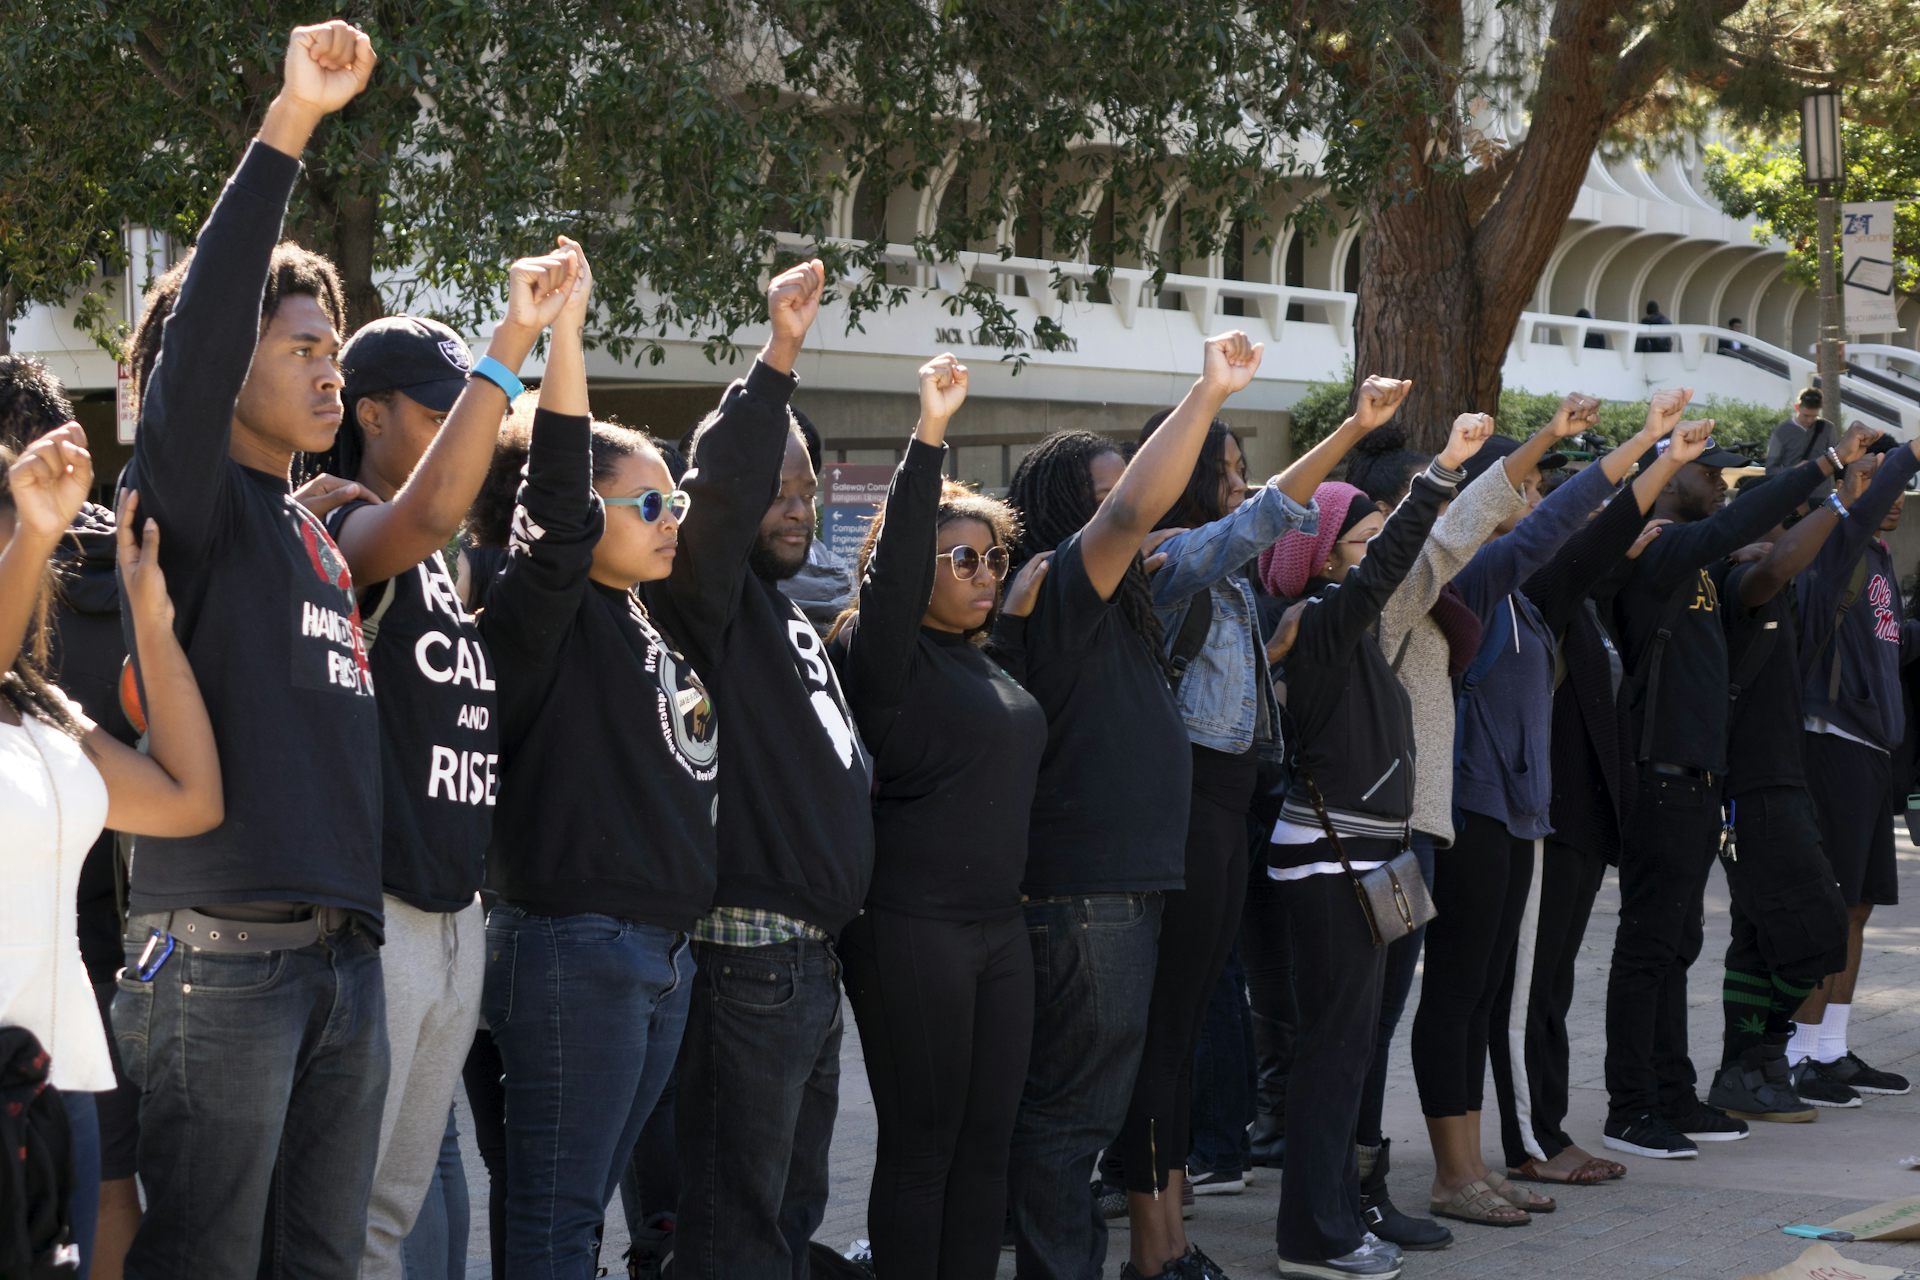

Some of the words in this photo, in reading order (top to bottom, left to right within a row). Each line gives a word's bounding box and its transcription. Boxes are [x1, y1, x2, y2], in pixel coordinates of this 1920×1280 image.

[935, 327, 964, 344] JACK
[832, 483, 866, 493] Gateway
[1868, 574, 1892, 608] Ole
[302, 601, 355, 650] HANDS
[457, 704, 489, 730] AND
[428, 745, 498, 806] RISE
